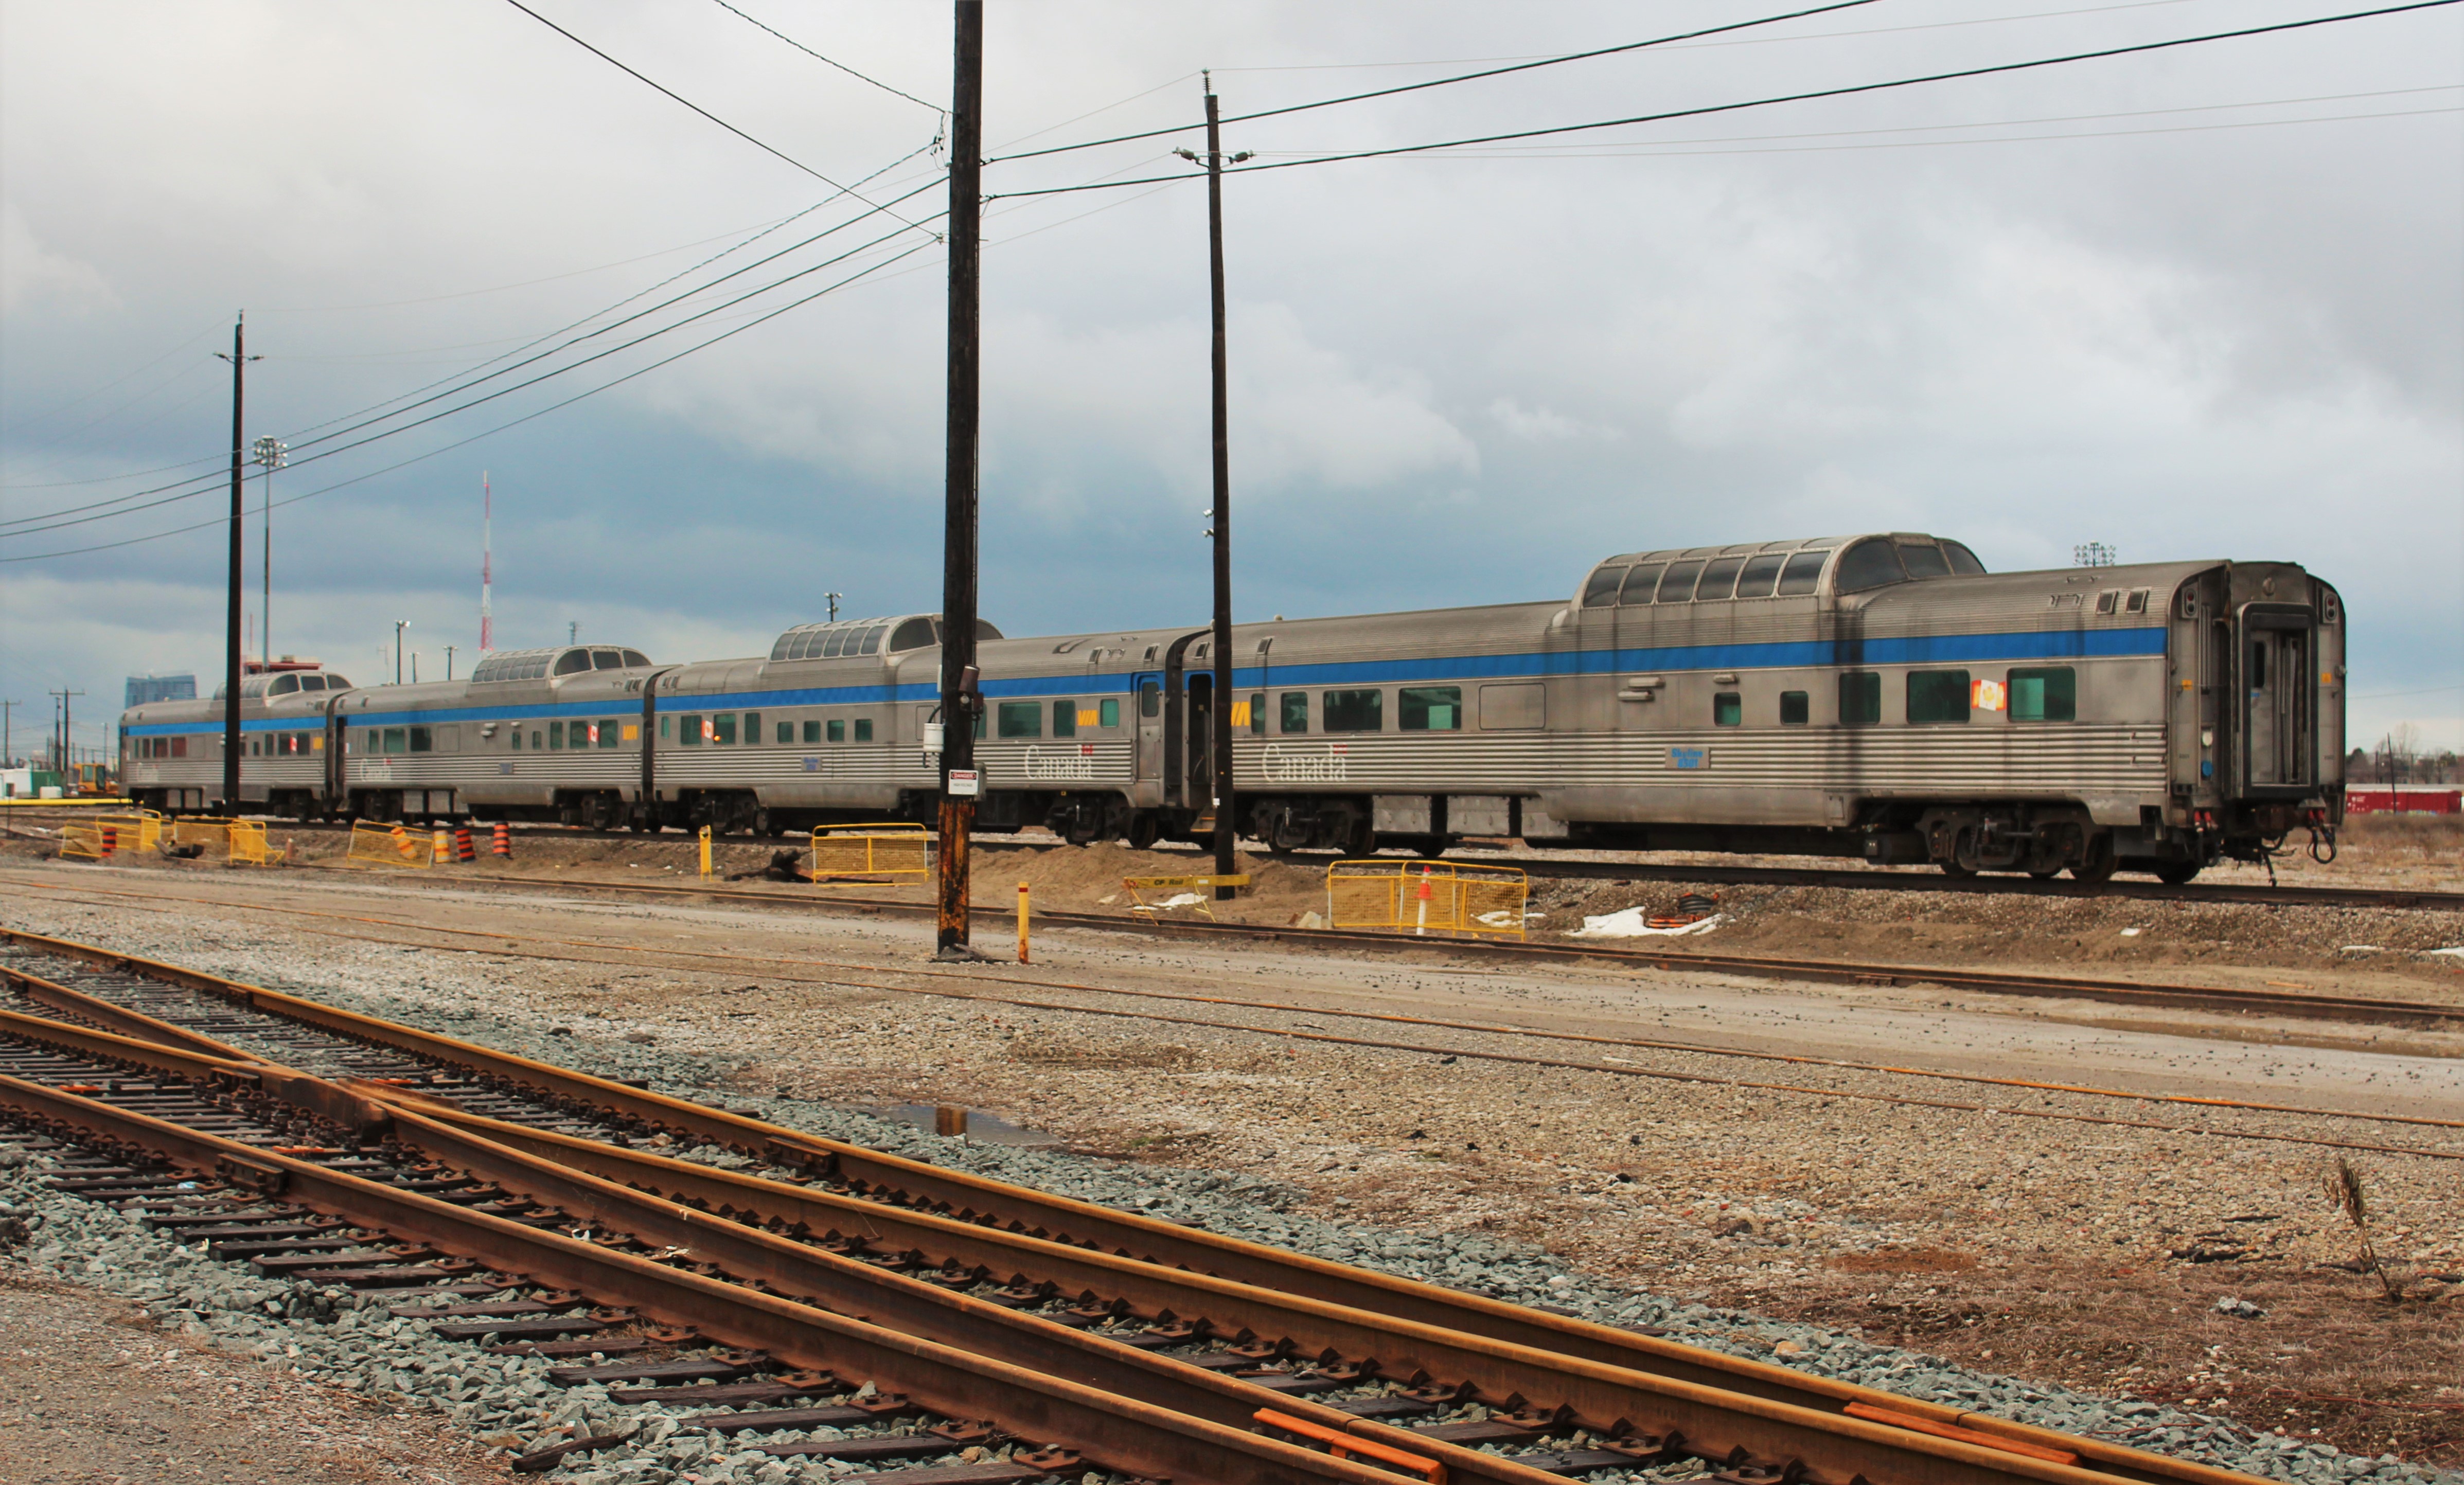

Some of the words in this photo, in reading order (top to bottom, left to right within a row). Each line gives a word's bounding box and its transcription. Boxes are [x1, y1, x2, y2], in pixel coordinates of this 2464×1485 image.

[1231, 702, 1250, 726] IA
[1025, 744, 1092, 779] Canada
[1263, 743, 1347, 782] Canada
[1671, 748, 1703, 759] Skyline
